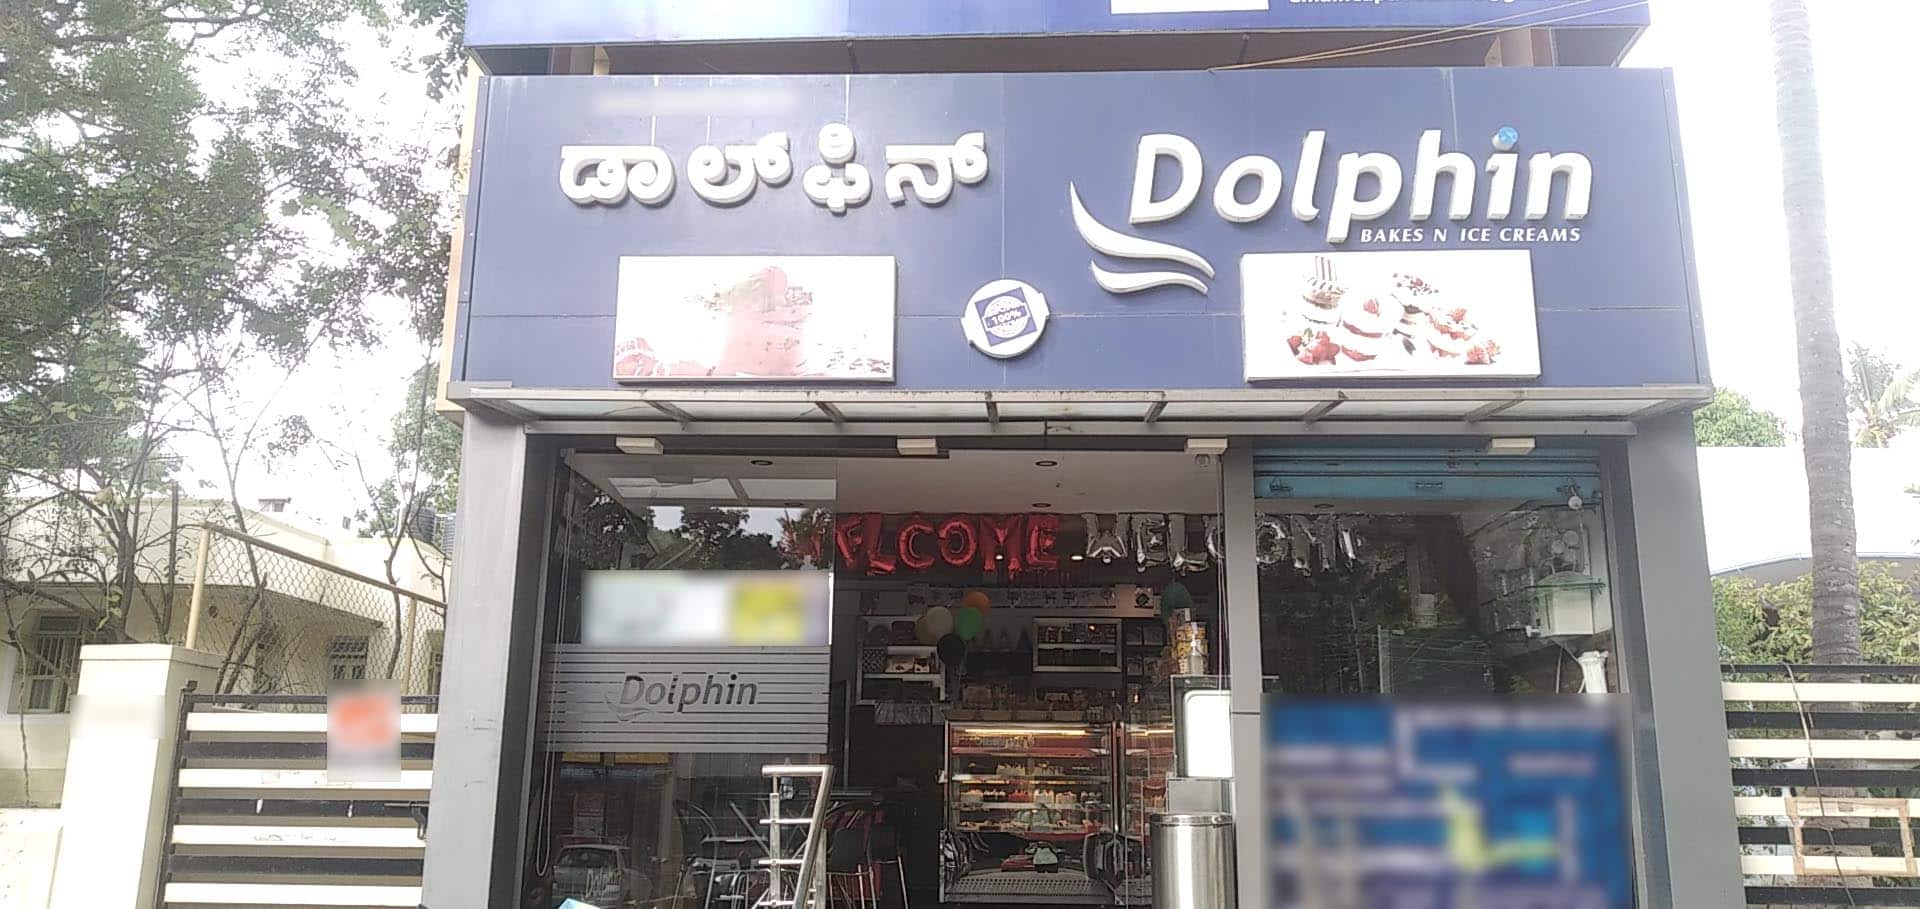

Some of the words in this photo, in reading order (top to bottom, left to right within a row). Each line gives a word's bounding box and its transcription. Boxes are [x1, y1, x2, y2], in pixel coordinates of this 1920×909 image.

[1130, 126, 1593, 243] Dolphin
[1361, 227, 1424, 243] BAKES
[1433, 228, 1449, 243] N
[1460, 228, 1491, 242] ICE
[1499, 228, 1581, 242] CREAMS
[620, 674, 758, 713] Dolphin
